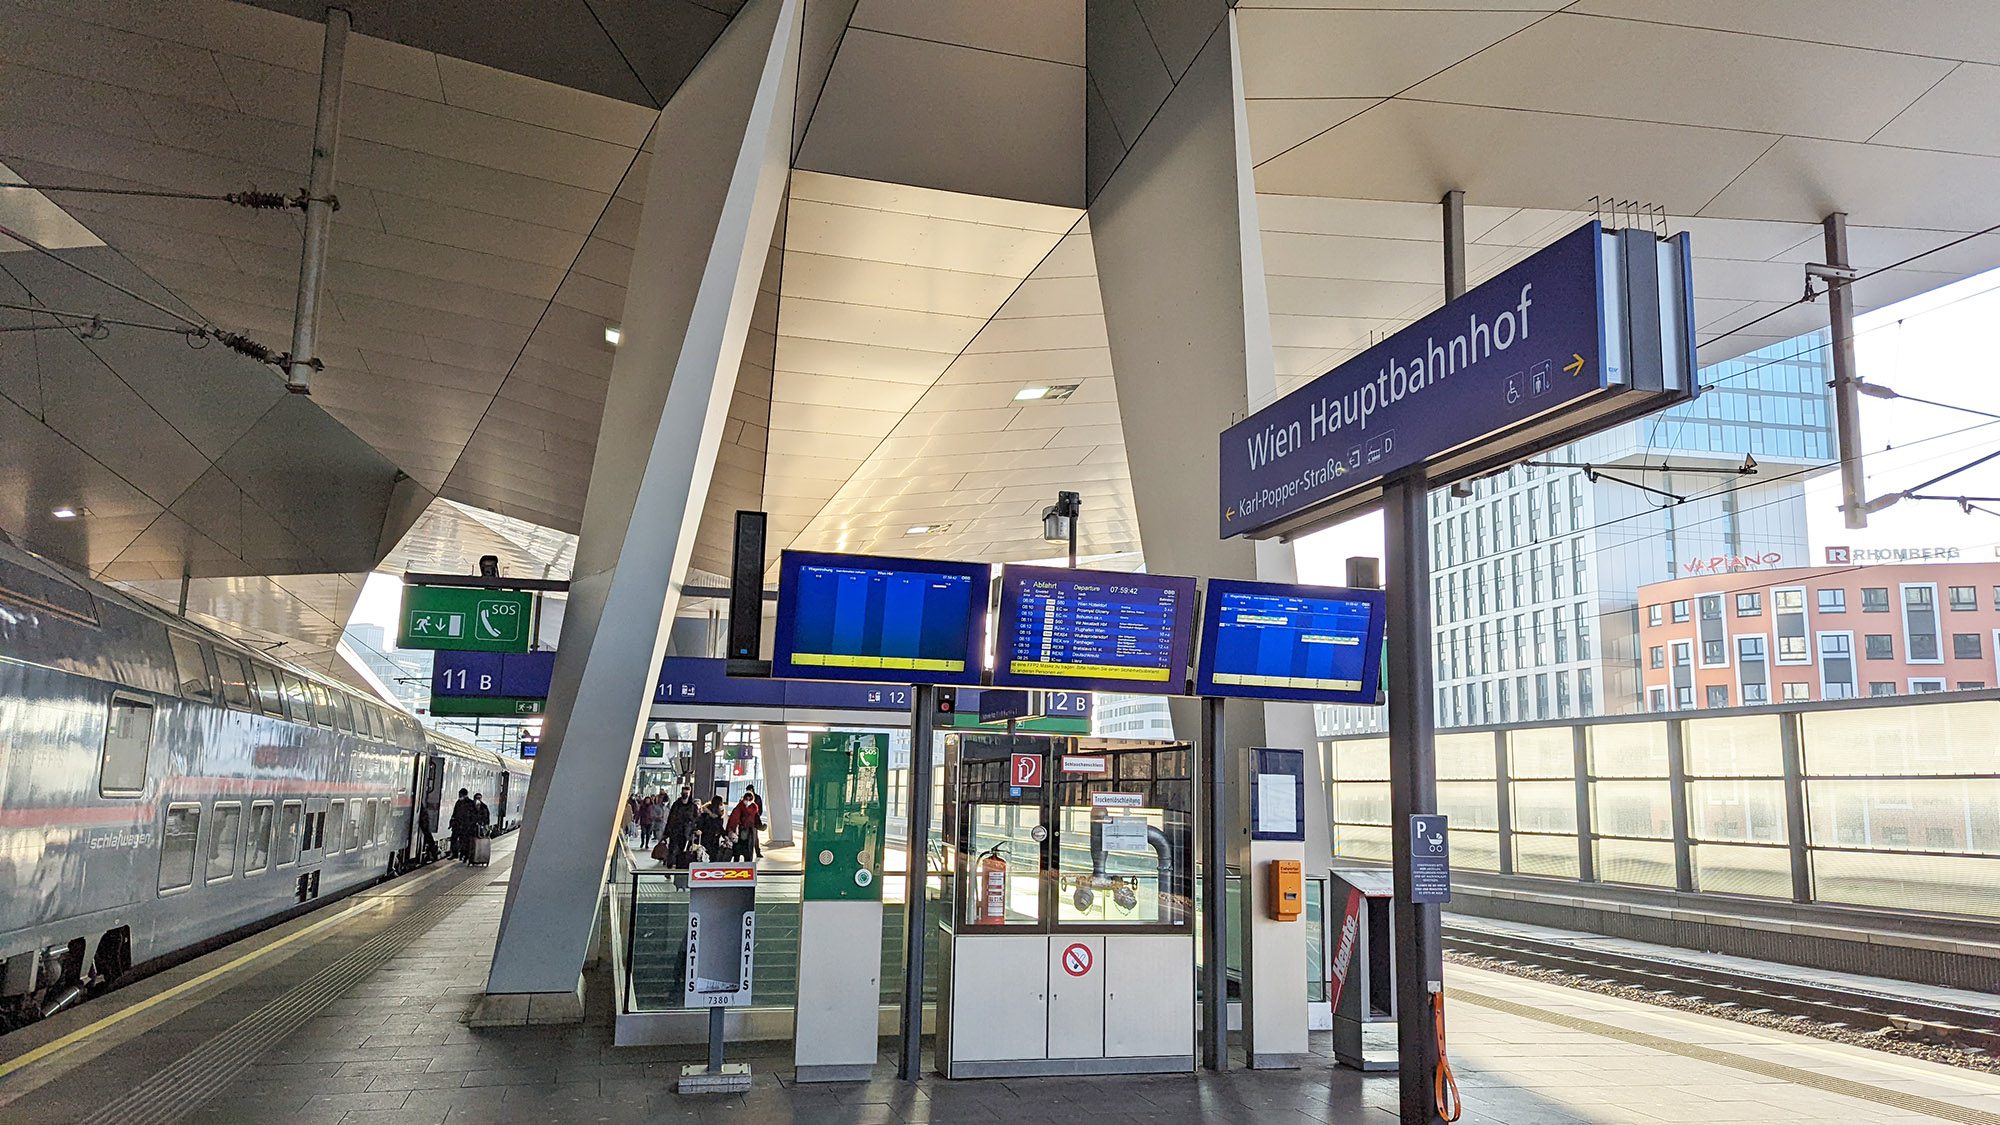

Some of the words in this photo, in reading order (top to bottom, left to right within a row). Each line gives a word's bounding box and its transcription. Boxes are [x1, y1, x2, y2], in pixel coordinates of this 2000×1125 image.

[1247, 420, 1301, 471] Wien
[1310, 282, 1533, 442] Hauptbahnhof
[1384, 437, 1393, 454] D
[1238, 457, 1344, 518] Karl-Popper-Straße
[1683, 551, 1782, 573] VAPIANO
[1853, 547, 1961, 560] RHOMBERG
[1110, 586, 1138, 594] 07:59:42
[492, 604, 516, 615] SOS
[442, 668, 466, 689] 11
[480, 674, 492, 690] B
[658, 683, 673, 696] 11
[889, 692, 905, 704] 12
[1047, 692, 1068, 710] 12
[1076, 698, 1086, 711] B
[1416, 821, 1427, 839] P
[90, 830, 151, 850] schlafwagen
[688, 917, 698, 992] GRATIS
[743, 916, 751, 991] GRATIS
[1333, 914, 1355, 982] Heute
[708, 996, 729, 1004] 7380
